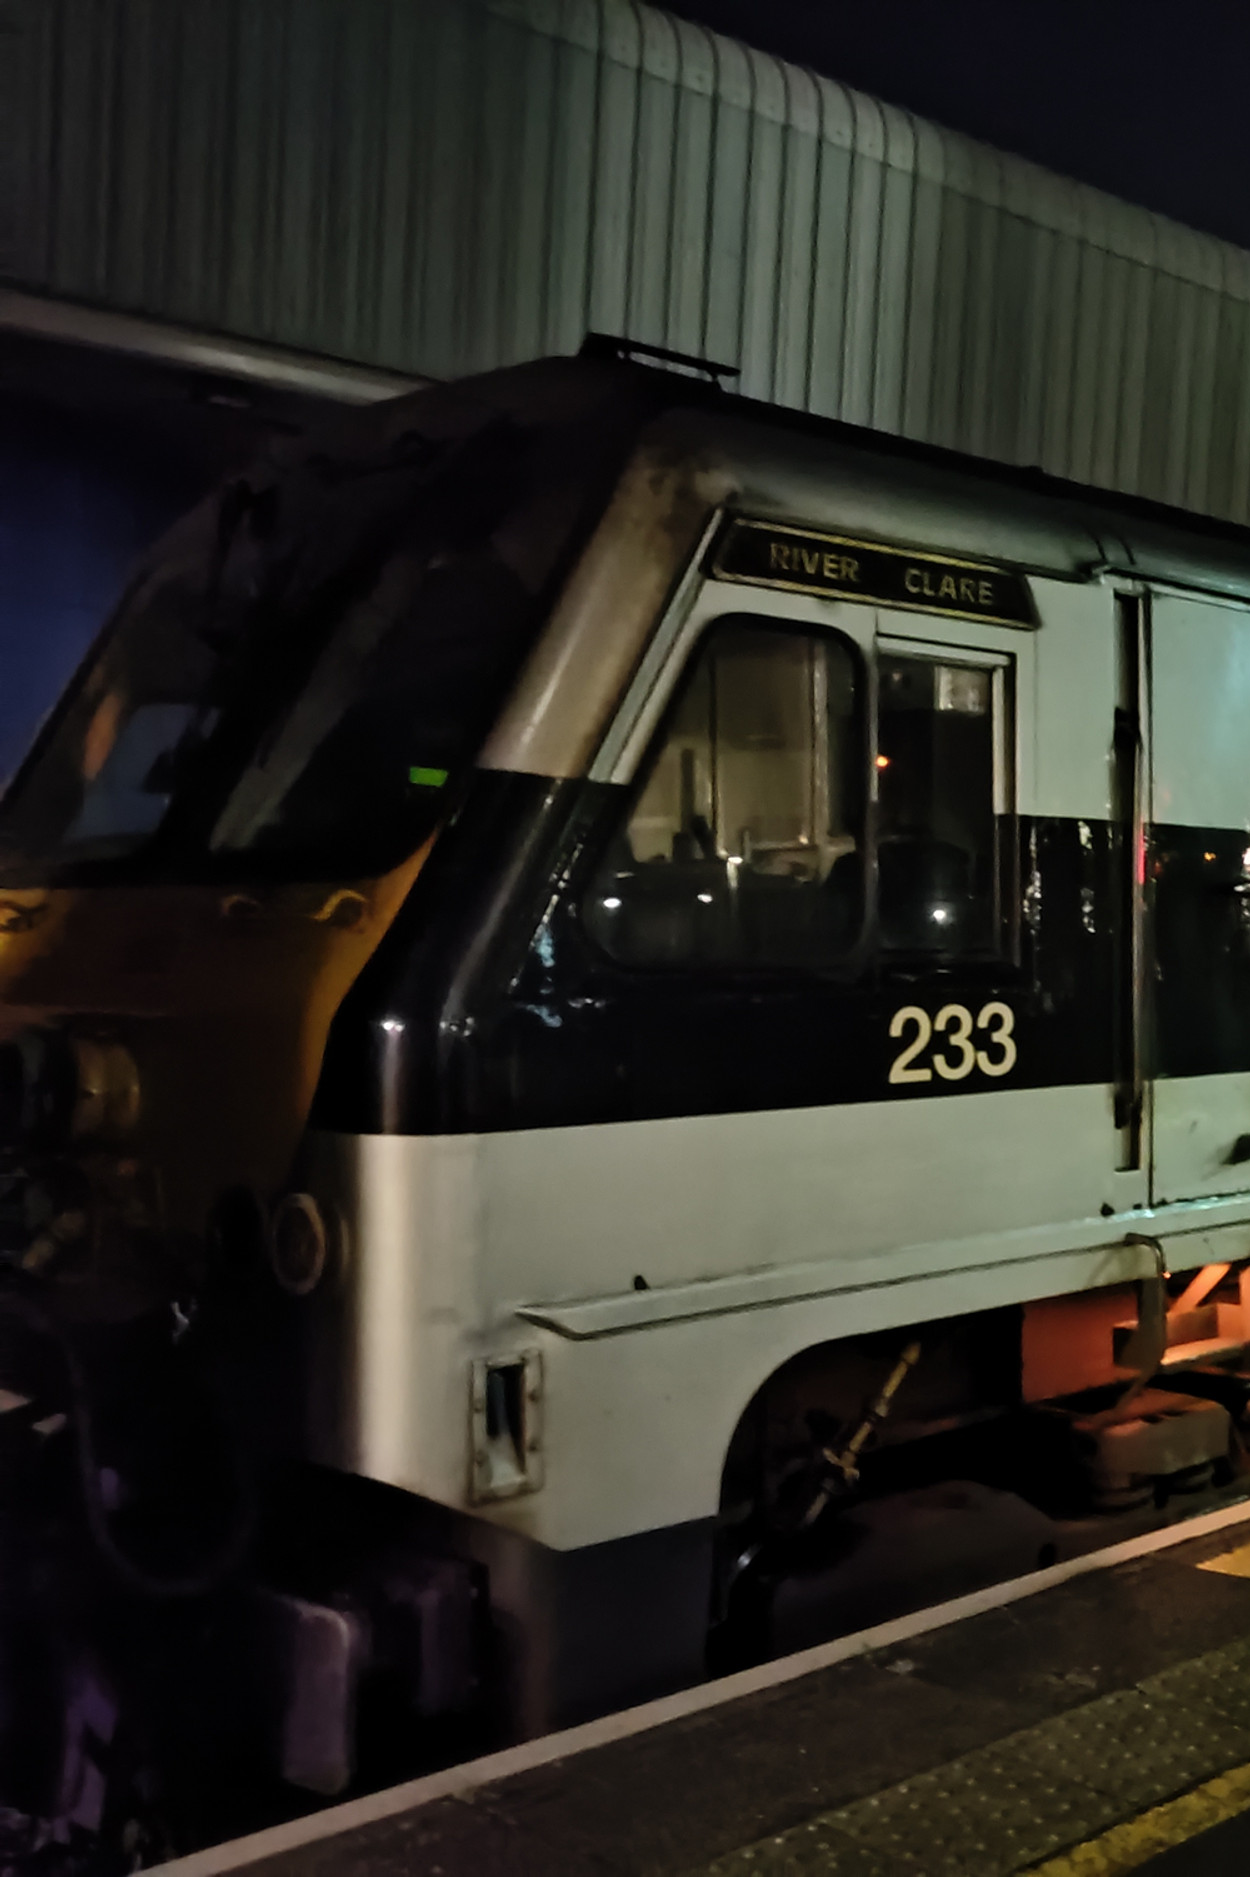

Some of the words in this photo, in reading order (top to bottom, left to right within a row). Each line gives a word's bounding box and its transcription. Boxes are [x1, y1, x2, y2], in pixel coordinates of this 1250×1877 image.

[769, 542, 861, 583] RIVER
[904, 568, 994, 605] CLARE
[888, 1001, 1017, 1084] 233
